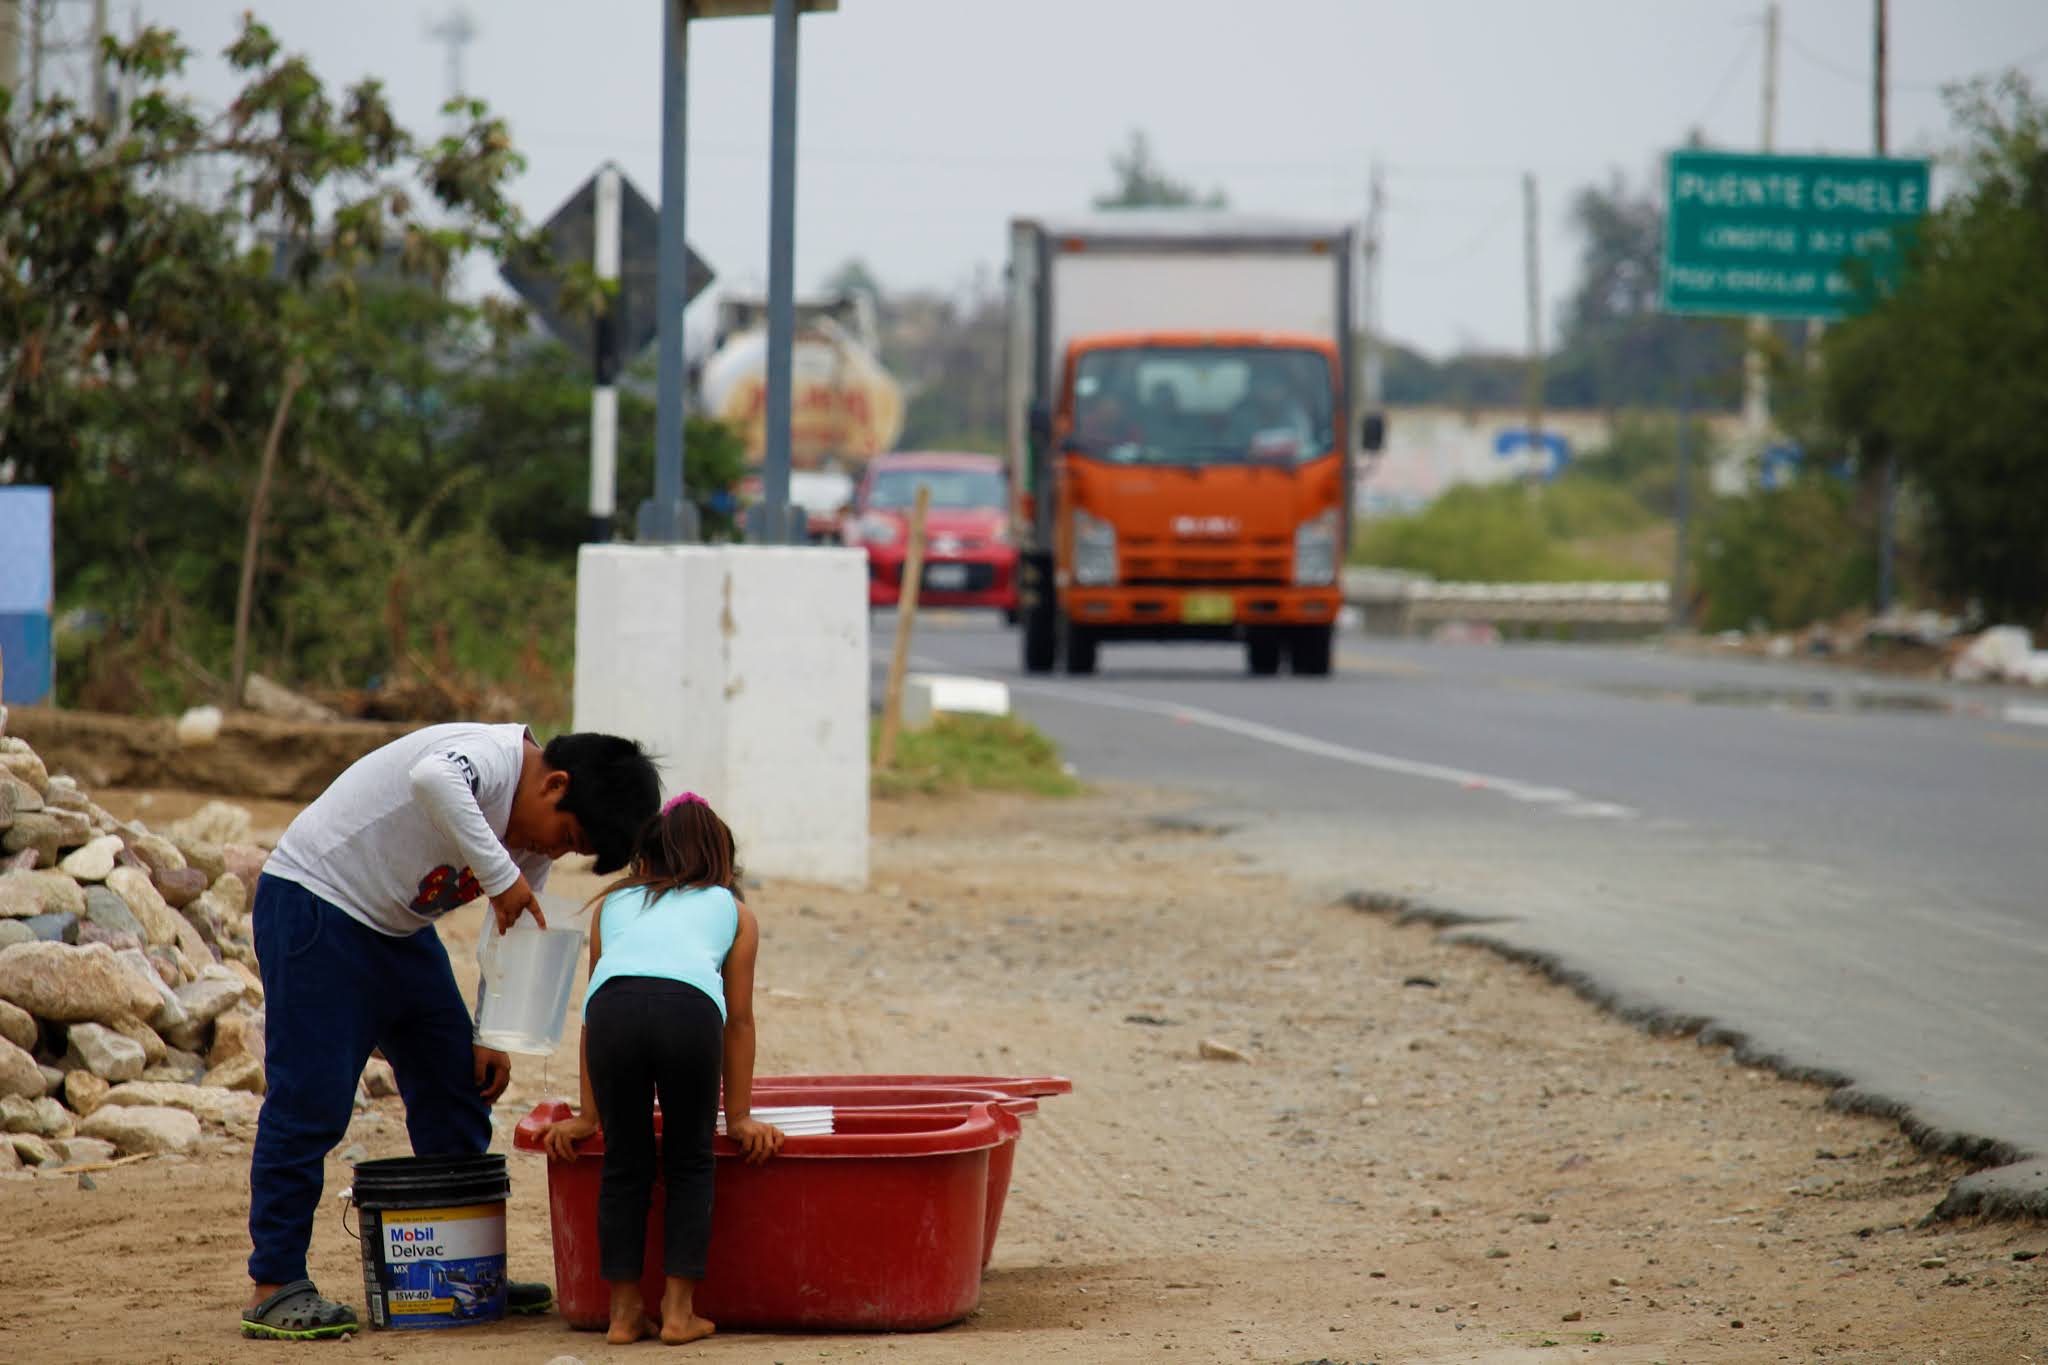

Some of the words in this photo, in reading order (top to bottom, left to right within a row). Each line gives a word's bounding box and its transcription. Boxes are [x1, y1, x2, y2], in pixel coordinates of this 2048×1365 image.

[1677, 173, 1803, 209] PUENTE
[391, 1227, 434, 1242] Mobil
[392, 1244, 444, 1258] Delvac
[393, 1264, 409, 1274] MX
[395, 1290, 430, 1301] 15W-40
